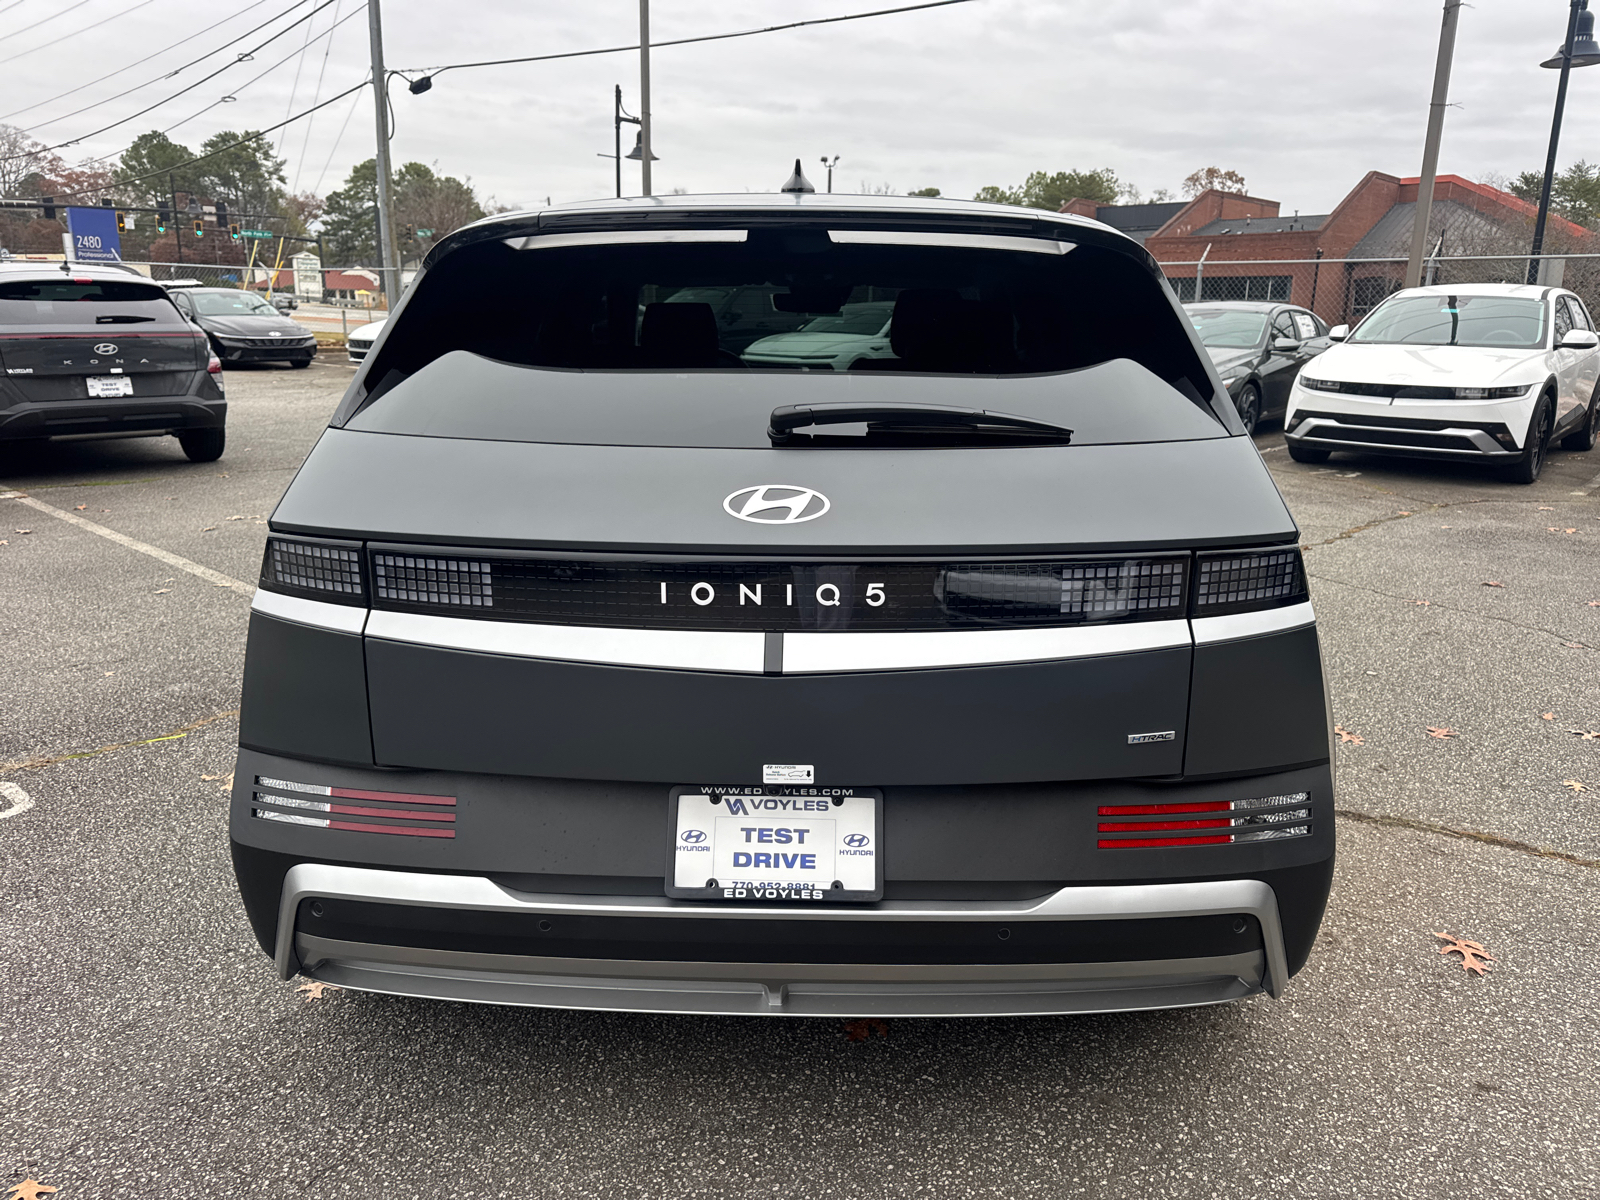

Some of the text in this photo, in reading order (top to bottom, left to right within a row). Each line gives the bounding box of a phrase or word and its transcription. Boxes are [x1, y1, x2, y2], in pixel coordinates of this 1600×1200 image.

[76, 235, 102, 249] 2480
[78, 251, 114, 259] Professional
[660, 582, 886, 607] IONIQ 5
[1131, 733, 1173, 743] HTRAC
[700, 786, 854, 796] WWW.EDYLES.COM
[749, 798, 829, 812] VOYLES
[740, 827, 810, 845] TEST
[732, 851, 817, 870] DRIVE
[723, 888, 824, 900] ED VOYLES
